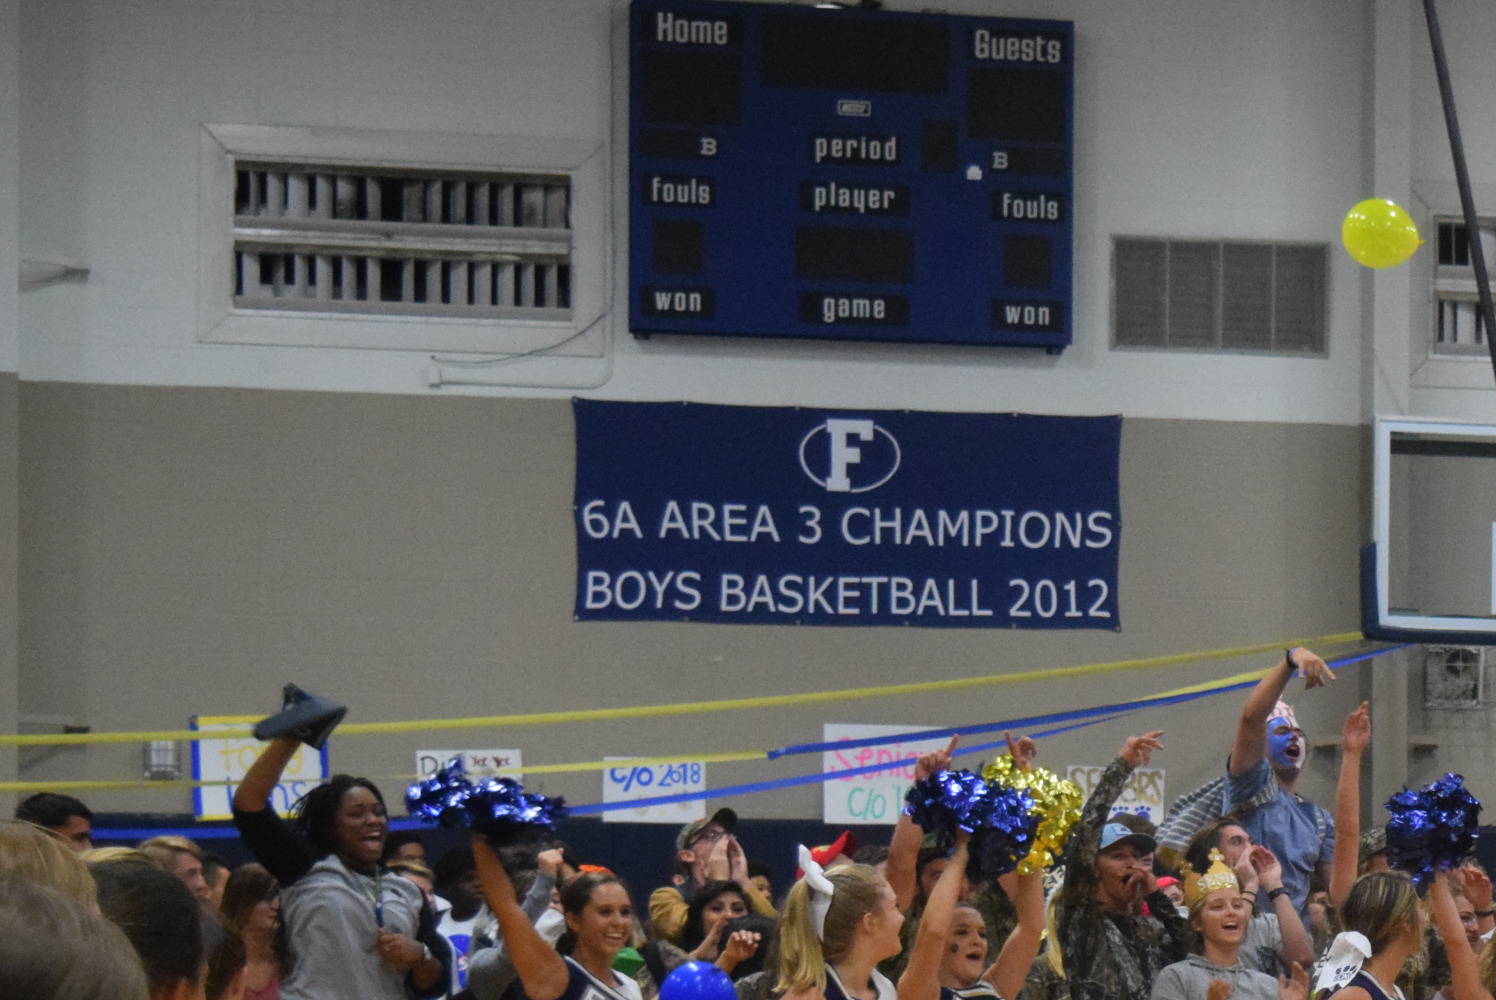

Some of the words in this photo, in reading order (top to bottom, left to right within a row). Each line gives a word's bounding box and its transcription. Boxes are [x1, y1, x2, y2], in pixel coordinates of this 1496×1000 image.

[657, 13, 728, 45] Home
[974, 30, 1061, 64] Guests
[700, 138, 717, 156] B
[815, 136, 897, 163] period
[992, 152, 1008, 170] B
[652, 178, 710, 204] fouls
[814, 185, 896, 213] player
[1002, 193, 1059, 220] fouls
[655, 291, 702, 312] won
[823, 296, 886, 322] game
[1006, 304, 1050, 326] won
[826, 419, 874, 492] F
[583, 500, 643, 539] 6A
[659, 501, 780, 544] AREA
[798, 507, 822, 544] 3
[841, 507, 1113, 549] CHAMPIONS
[585, 571, 701, 610] BOYS
[720, 575, 993, 617] BASKETBALL
[1008, 579, 1111, 618] 2012
